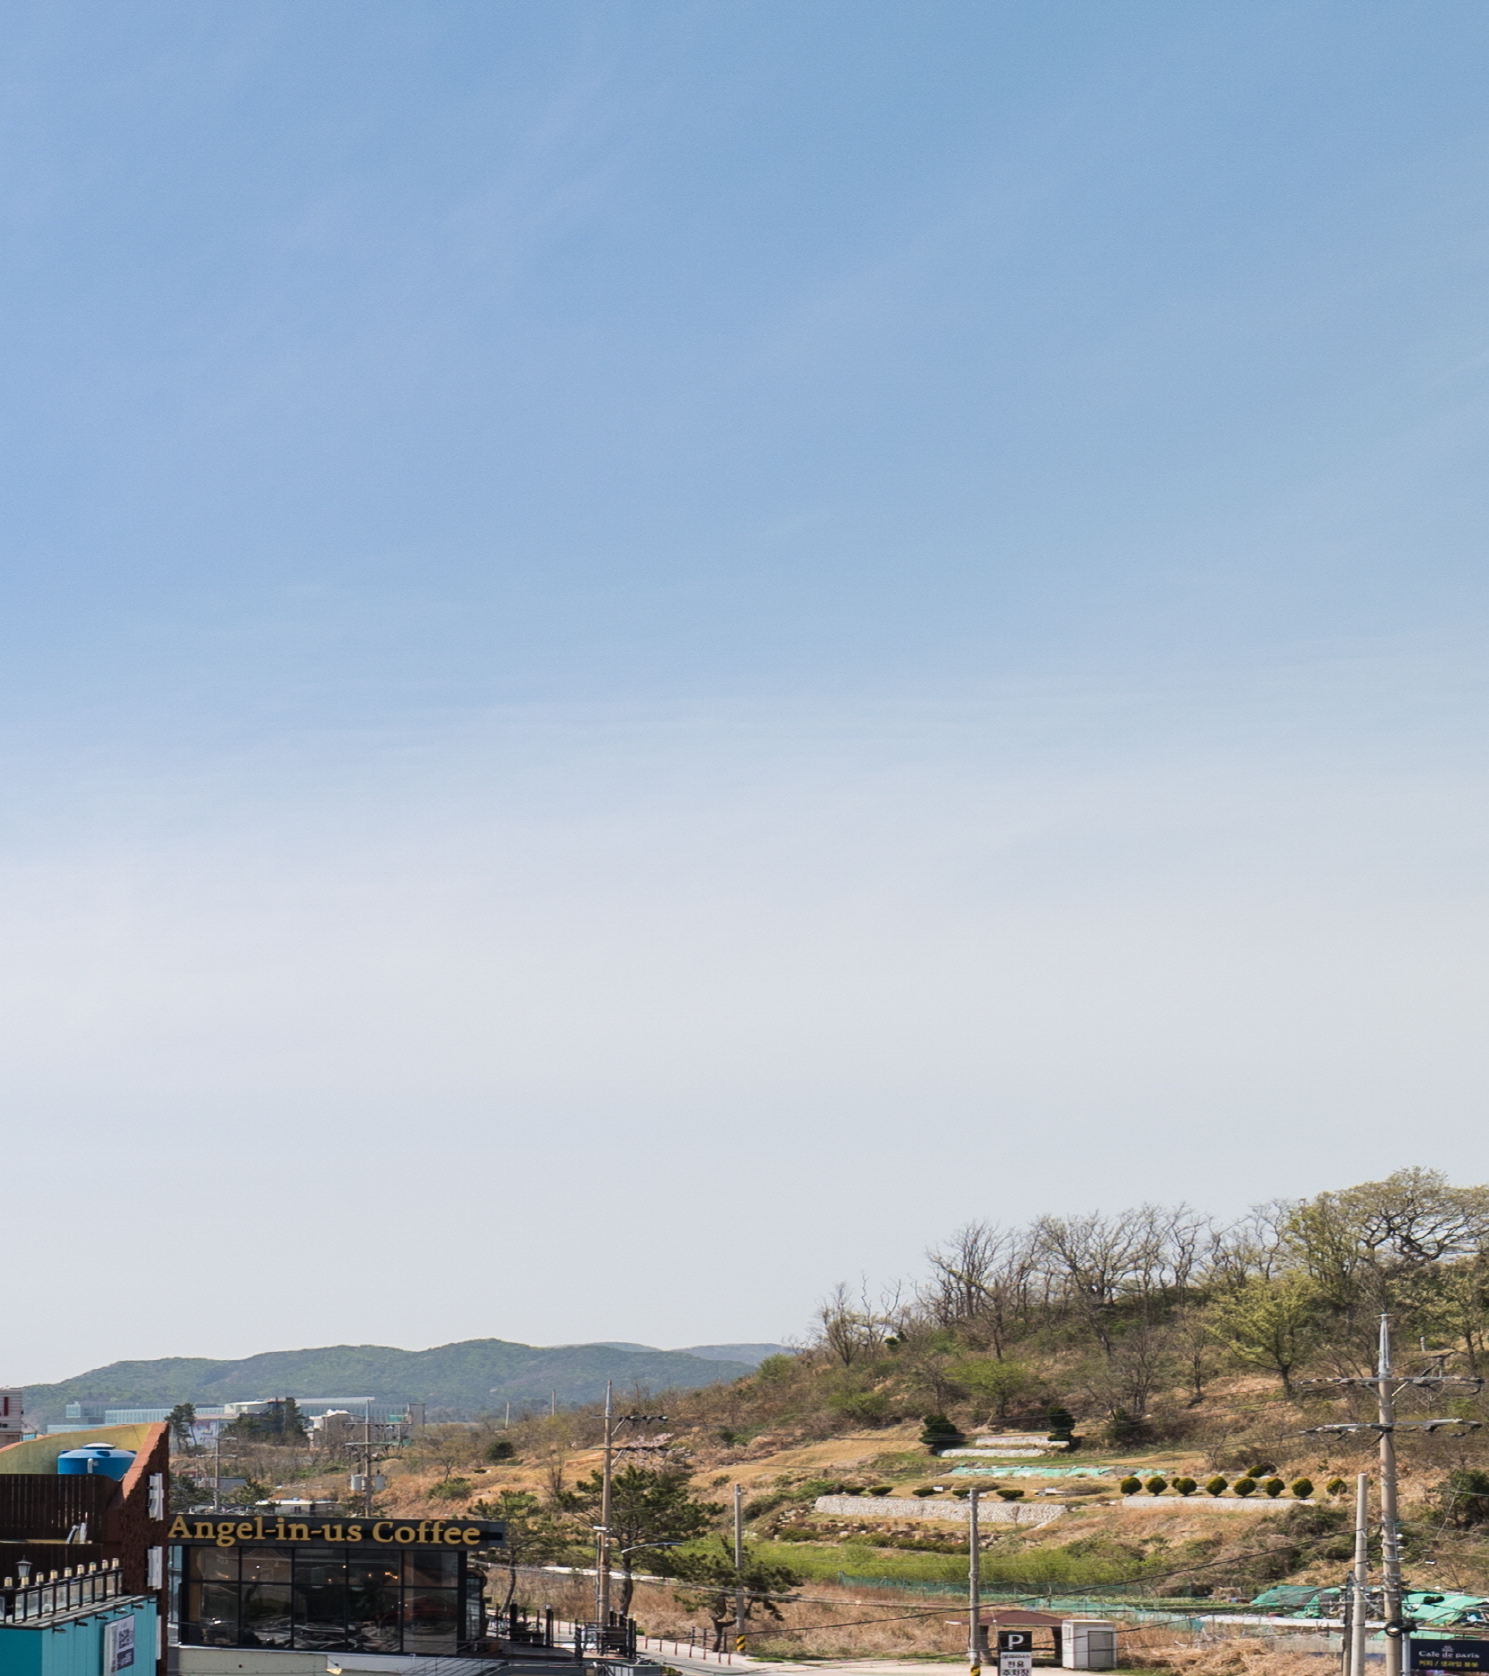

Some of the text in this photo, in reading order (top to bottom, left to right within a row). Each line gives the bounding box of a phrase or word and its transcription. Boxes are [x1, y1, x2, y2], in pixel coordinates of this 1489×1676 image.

[168, 1515, 481, 1547] Angel-in-us Coffee
[1008, 1634, 1024, 1650] P
[1455, 1651, 1480, 1659] paris
[1002, 1668, 1029, 1676] 주차장
